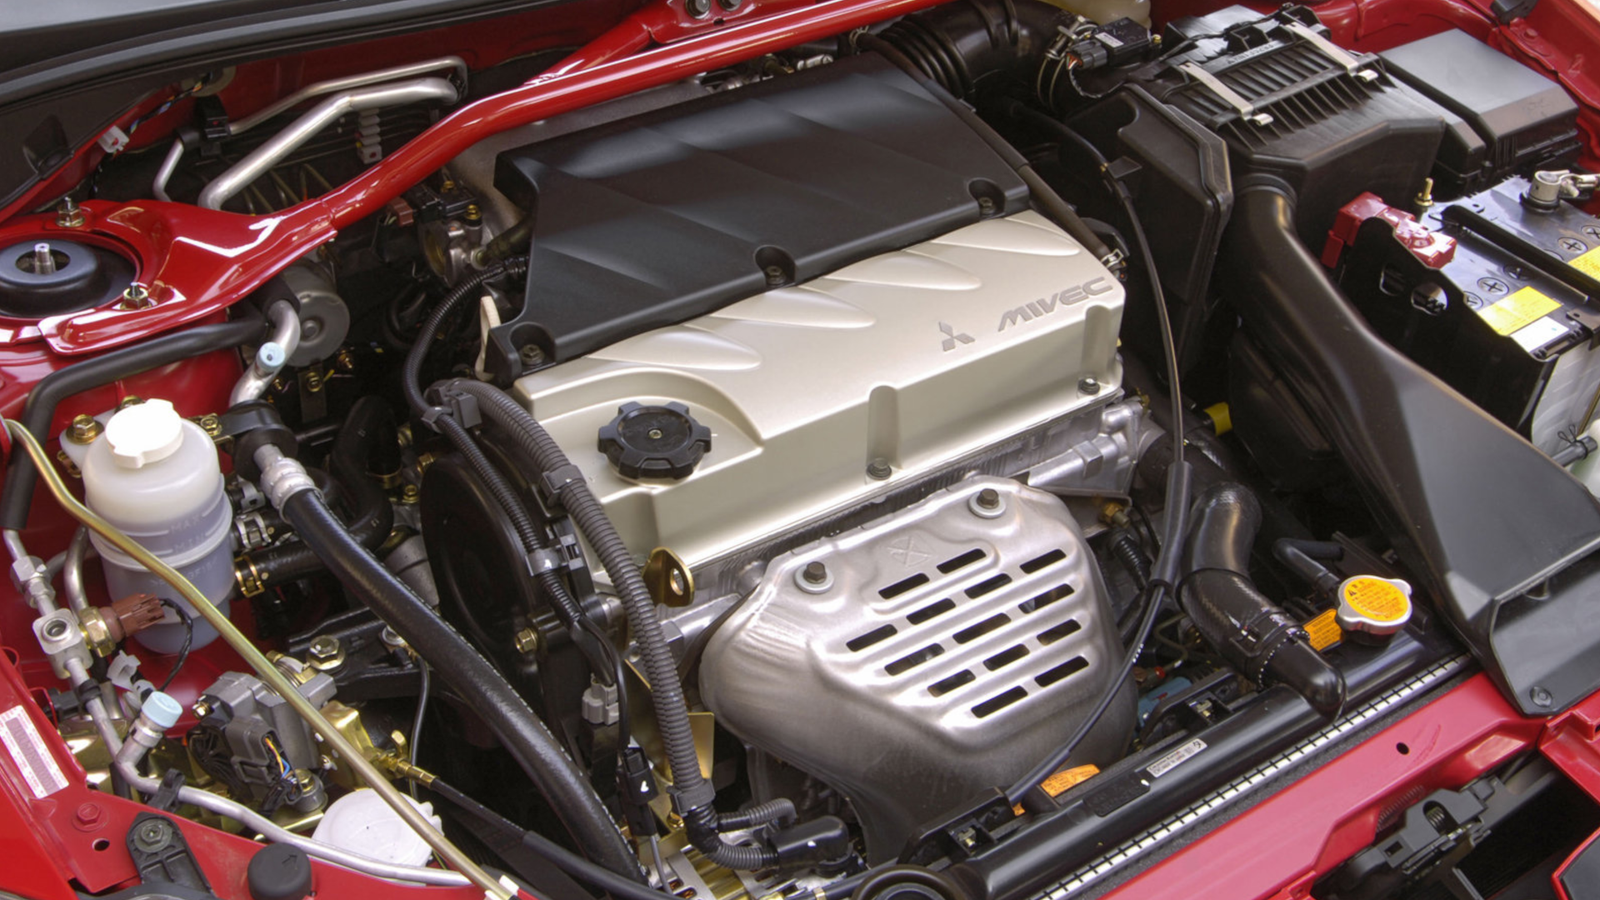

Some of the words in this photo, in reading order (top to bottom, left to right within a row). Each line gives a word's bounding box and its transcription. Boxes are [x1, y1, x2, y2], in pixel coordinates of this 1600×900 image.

[998, 276, 1113, 332] MIVEC
[170, 514, 200, 533] MAX
[173, 532, 204, 553] MIN
